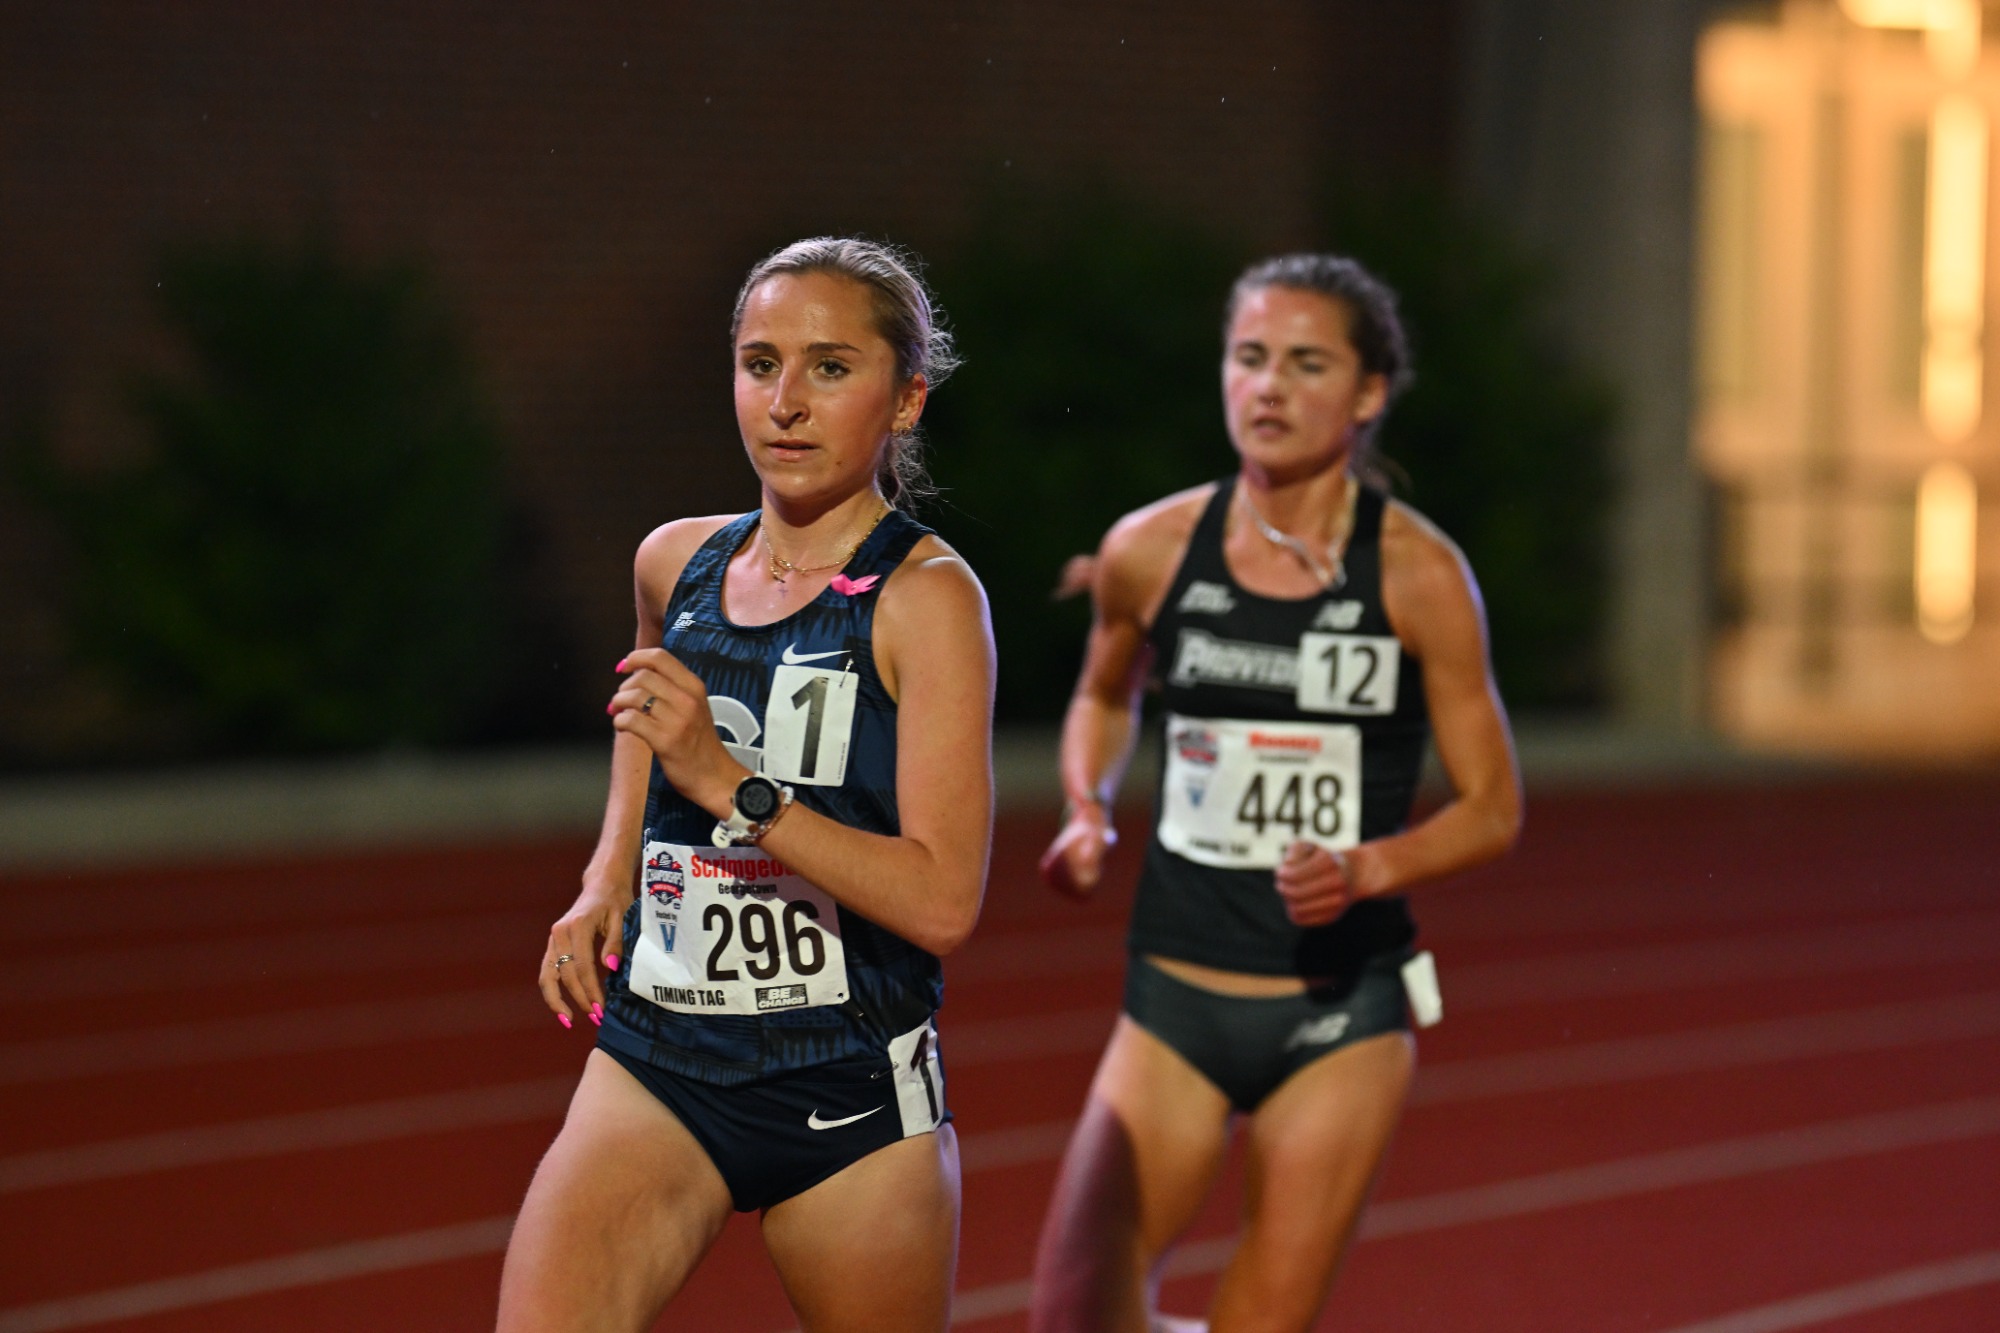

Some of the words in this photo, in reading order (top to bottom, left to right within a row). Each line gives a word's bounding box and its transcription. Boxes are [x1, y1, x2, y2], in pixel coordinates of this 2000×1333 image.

[1320, 644, 1380, 706] 12
[791, 676, 830, 779] 1
[1237, 772, 1343, 838] 448
[717, 882, 778, 896] Georgetown
[659, 921, 677, 953] V
[703, 900, 826, 982] 296
[652, 985, 696, 1006] TIMING
[697, 989, 726, 1006] TAG
[768, 987, 791, 1000] BE
[910, 1029, 939, 1124] 1
